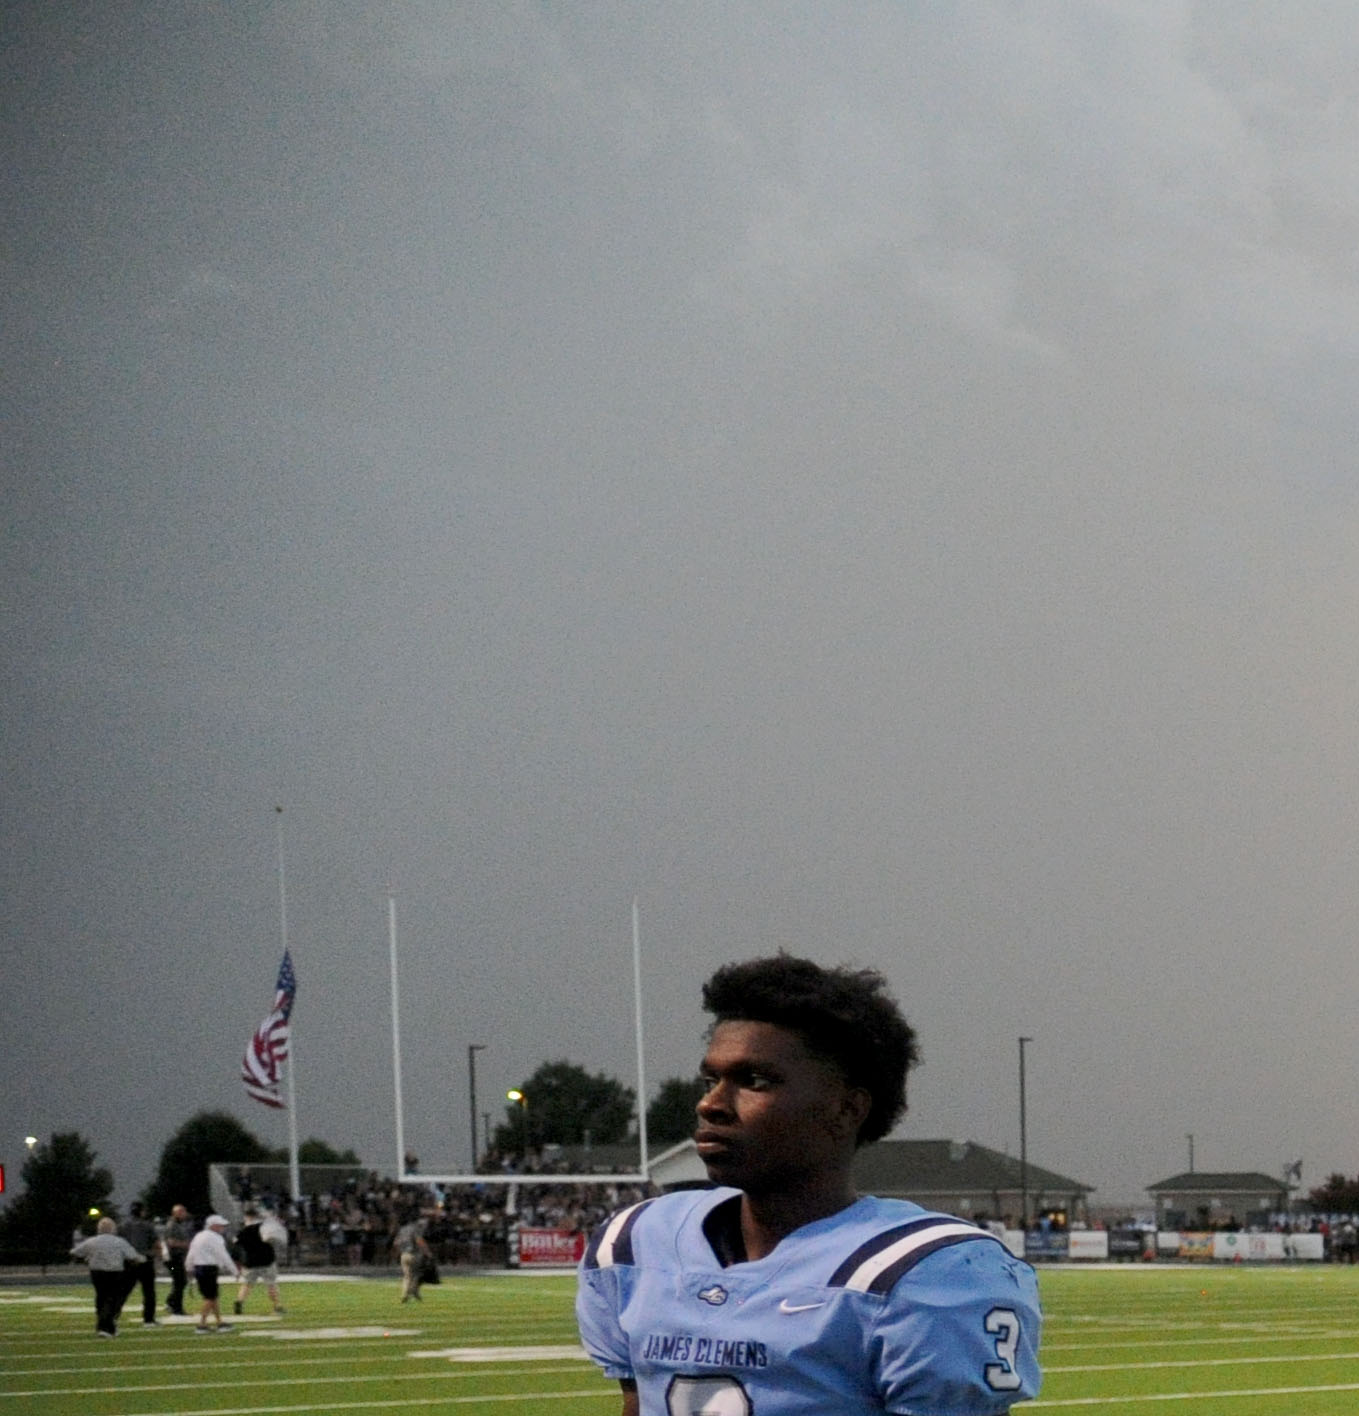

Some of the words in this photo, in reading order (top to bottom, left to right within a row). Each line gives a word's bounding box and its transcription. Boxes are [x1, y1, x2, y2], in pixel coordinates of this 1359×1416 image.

[643, 1334, 693, 1361] JAMES
[694, 1337, 768, 1368] CLEMENS
[983, 1307, 1024, 1393] 3
